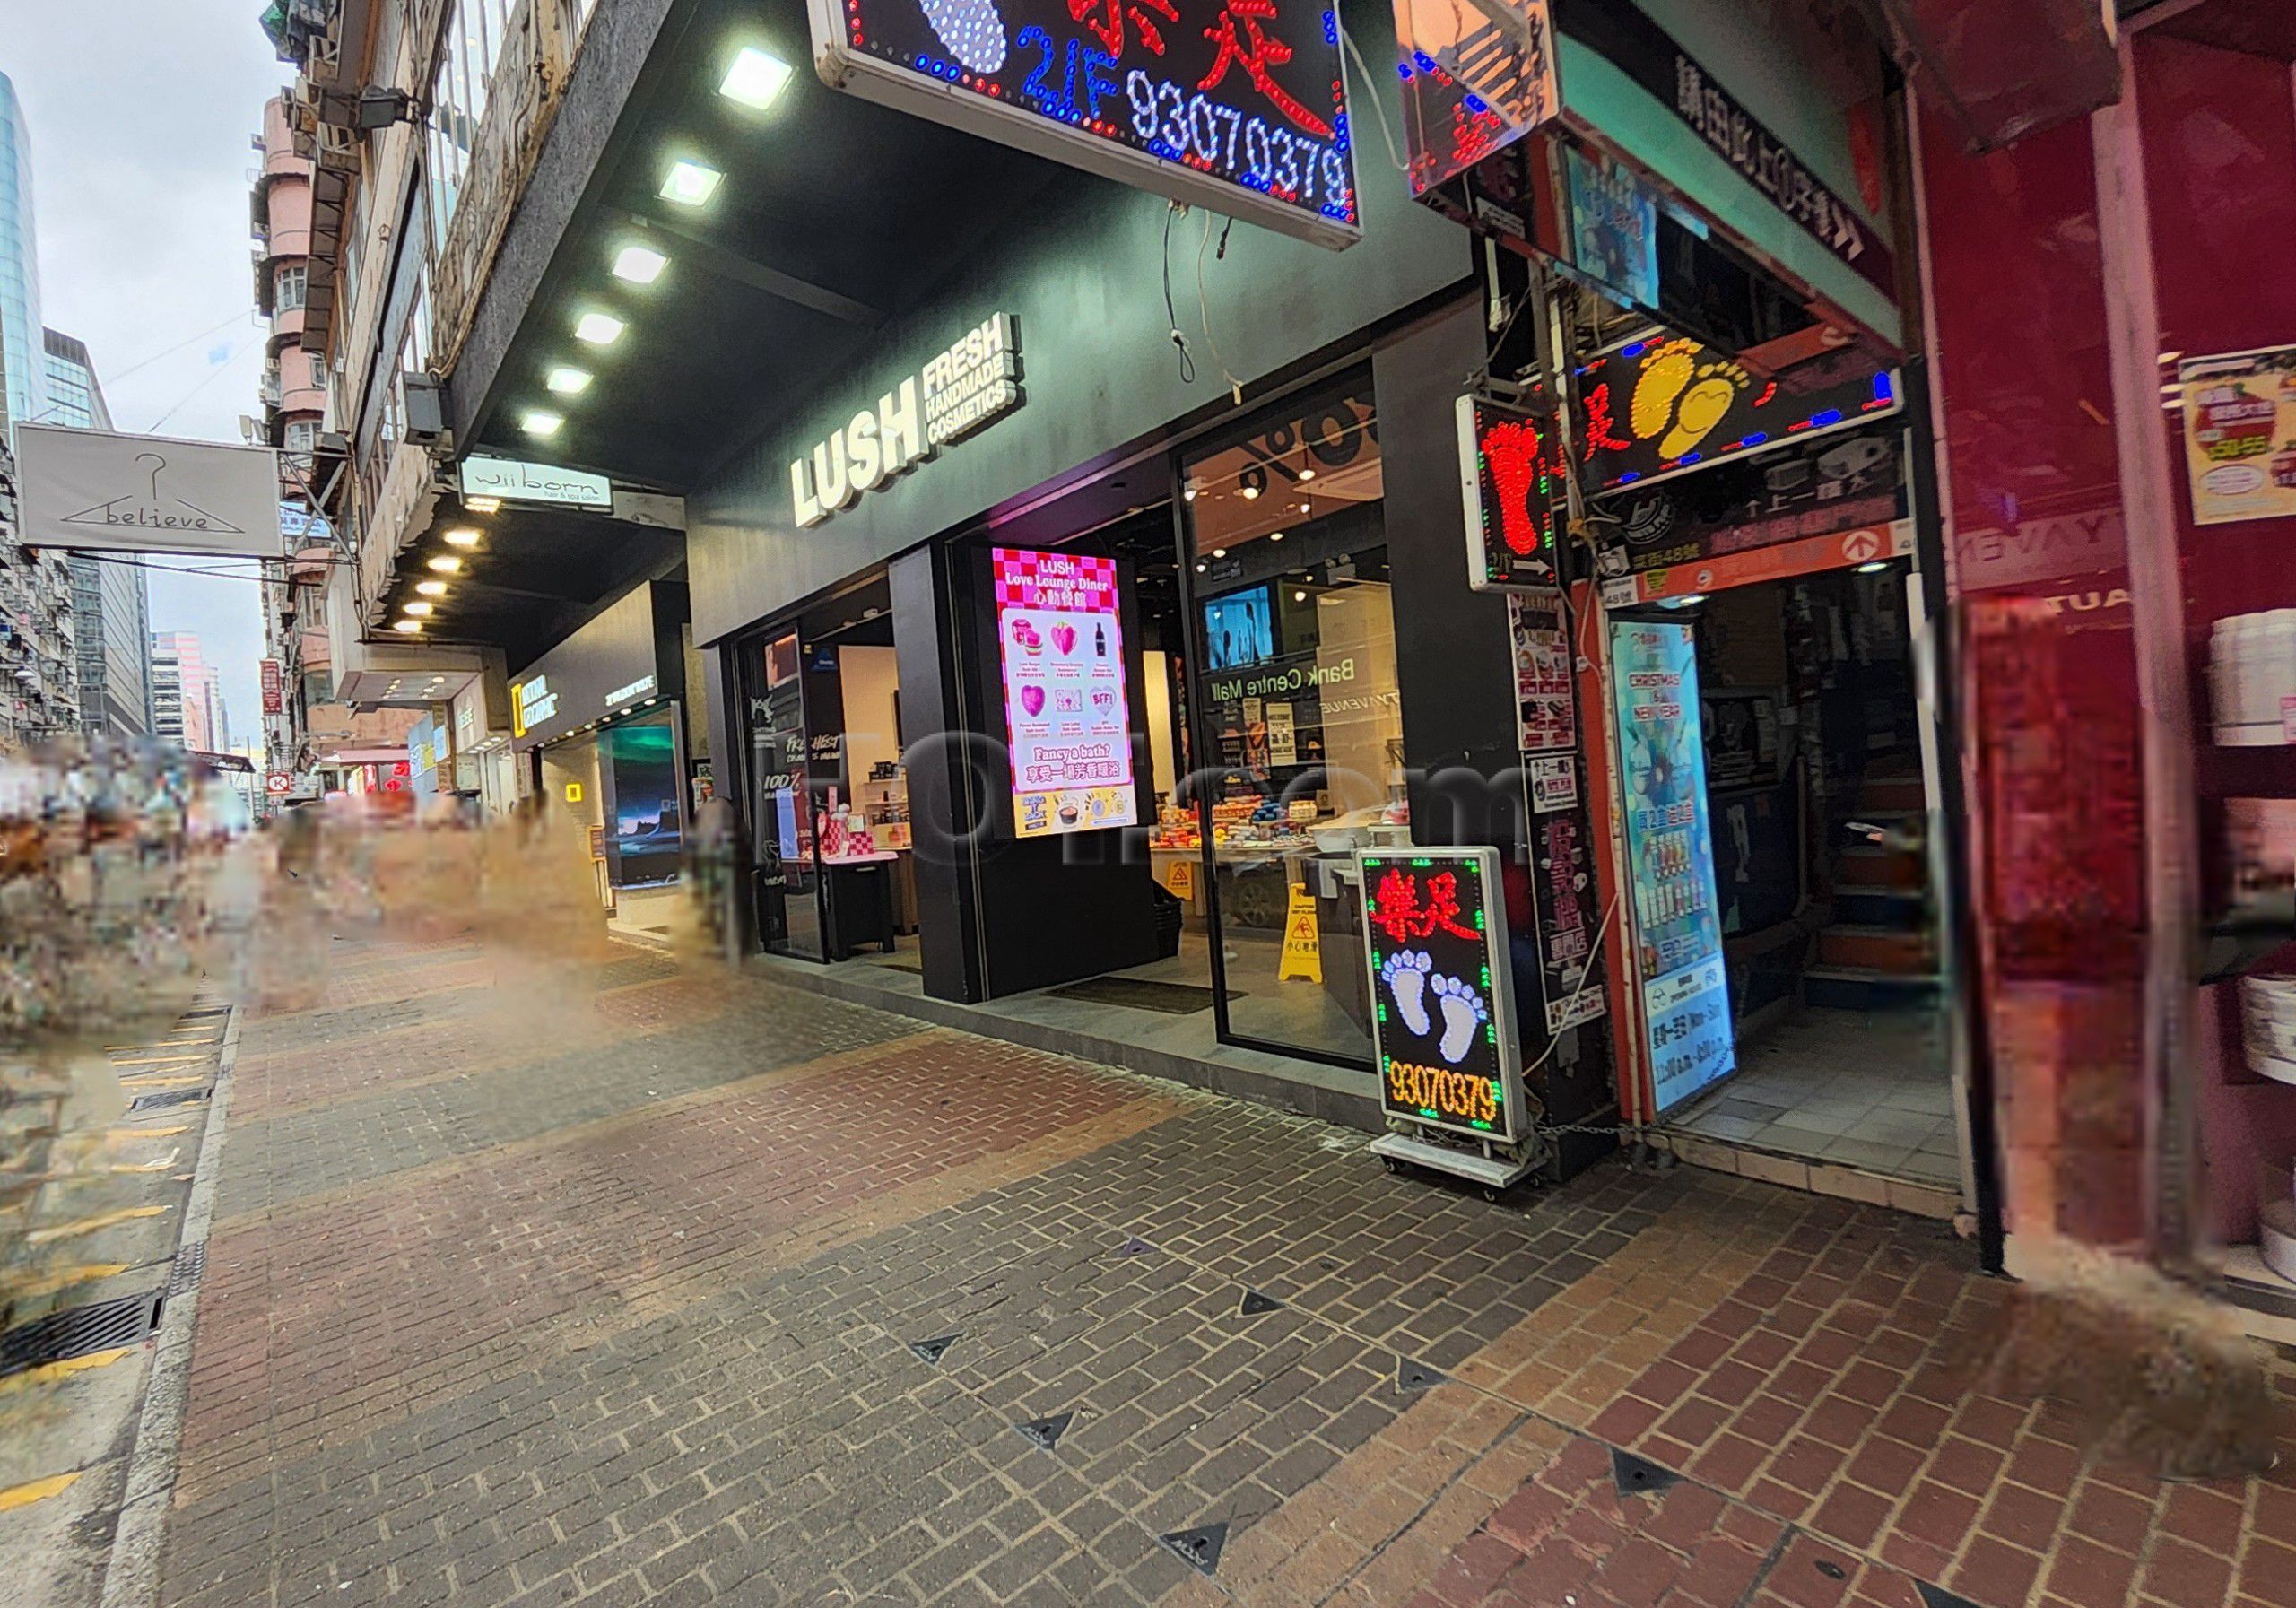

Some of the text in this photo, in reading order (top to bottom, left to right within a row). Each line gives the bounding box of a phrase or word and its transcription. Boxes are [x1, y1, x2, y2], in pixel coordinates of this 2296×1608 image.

[1016, 24, 1119, 121] 2/F
[1126, 68, 1348, 209] 93070379
[922, 311, 1006, 401] FRESH
[925, 351, 1007, 423] HANDMADE
[927, 378, 1010, 446] COSMETICS
[791, 375, 926, 527] LUSH
[106, 502, 209, 530] believe
[1039, 560, 1074, 575] LUSH
[1005, 572, 1109, 592] Love Lounge Diner
[1629, 674, 1680, 687] CHRISTMAS
[1092, 692, 1114, 705] BFF!
[787, 734, 840, 752] FREHEST
[1034, 743, 1111, 764] Fancy a bath?
[764, 772, 801, 790] 100%
[1389, 1060, 1498, 1122] 93070379
